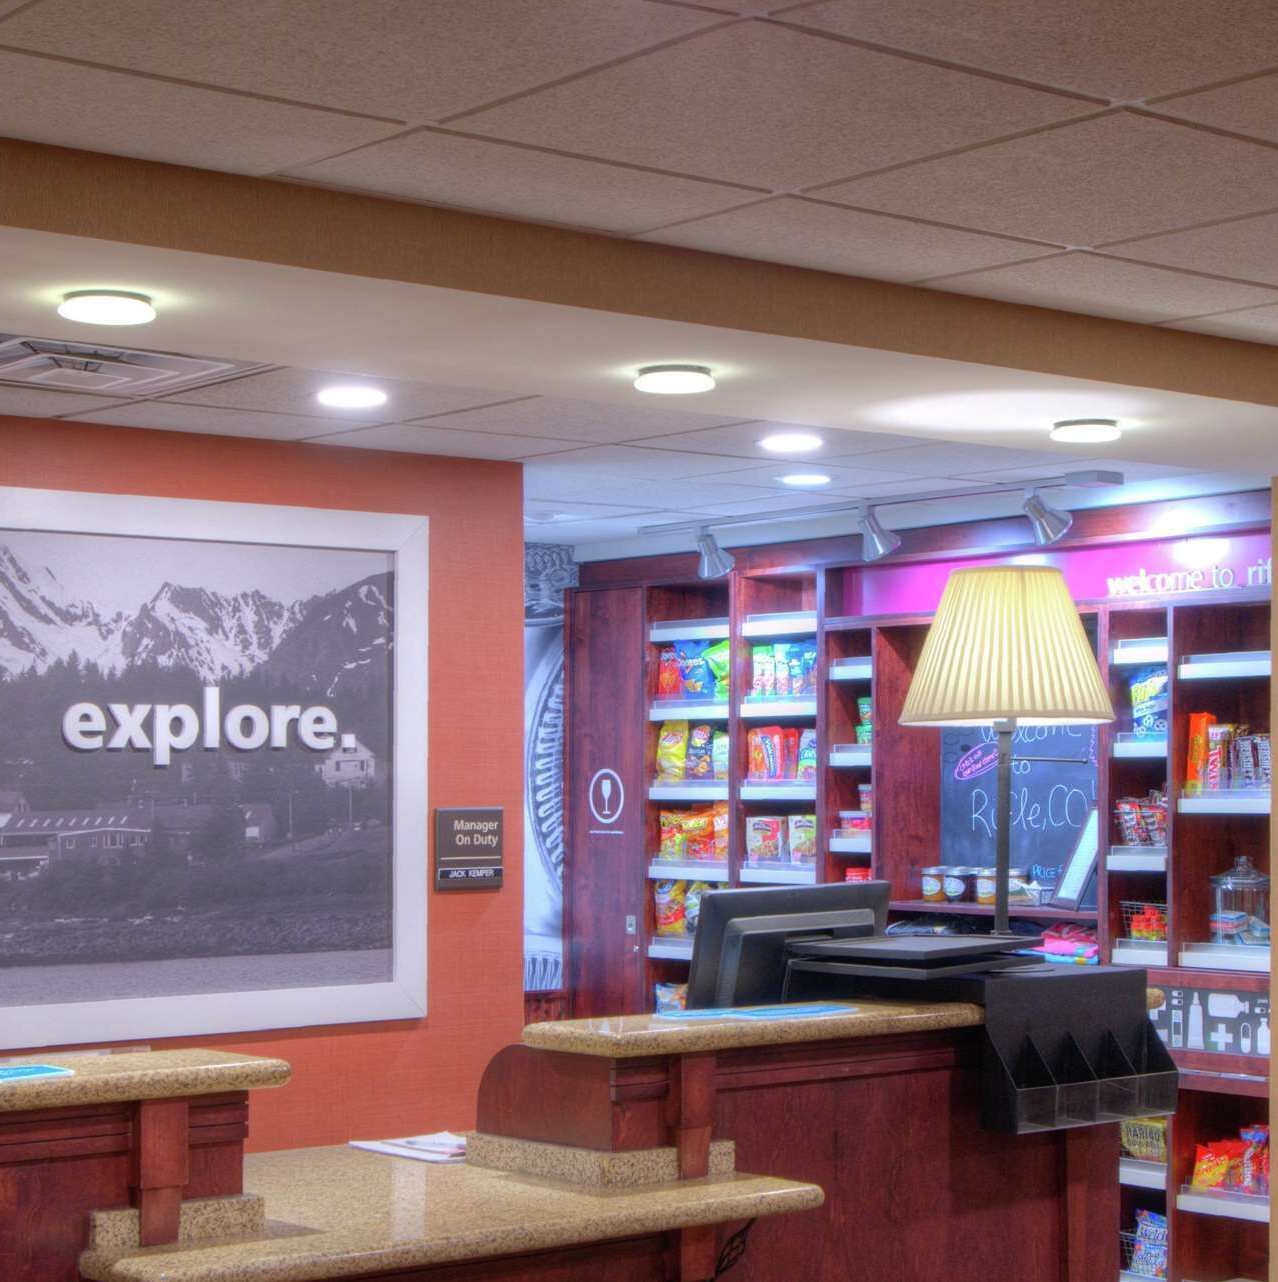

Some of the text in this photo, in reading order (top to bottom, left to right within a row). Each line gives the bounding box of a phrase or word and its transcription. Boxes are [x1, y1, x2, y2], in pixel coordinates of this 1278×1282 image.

[1107, 568, 1203, 596] welcome
[1211, 564, 1234, 588] to
[62, 686, 356, 769] explore.
[980, 726, 1082, 744] Wlcome
[1010, 754, 1031, 775] to
[971, 786, 1047, 838] Rile,
[453, 820, 499, 832] Manager
[455, 834, 499, 848] On Duty
[449, 869, 466, 879] JACK
